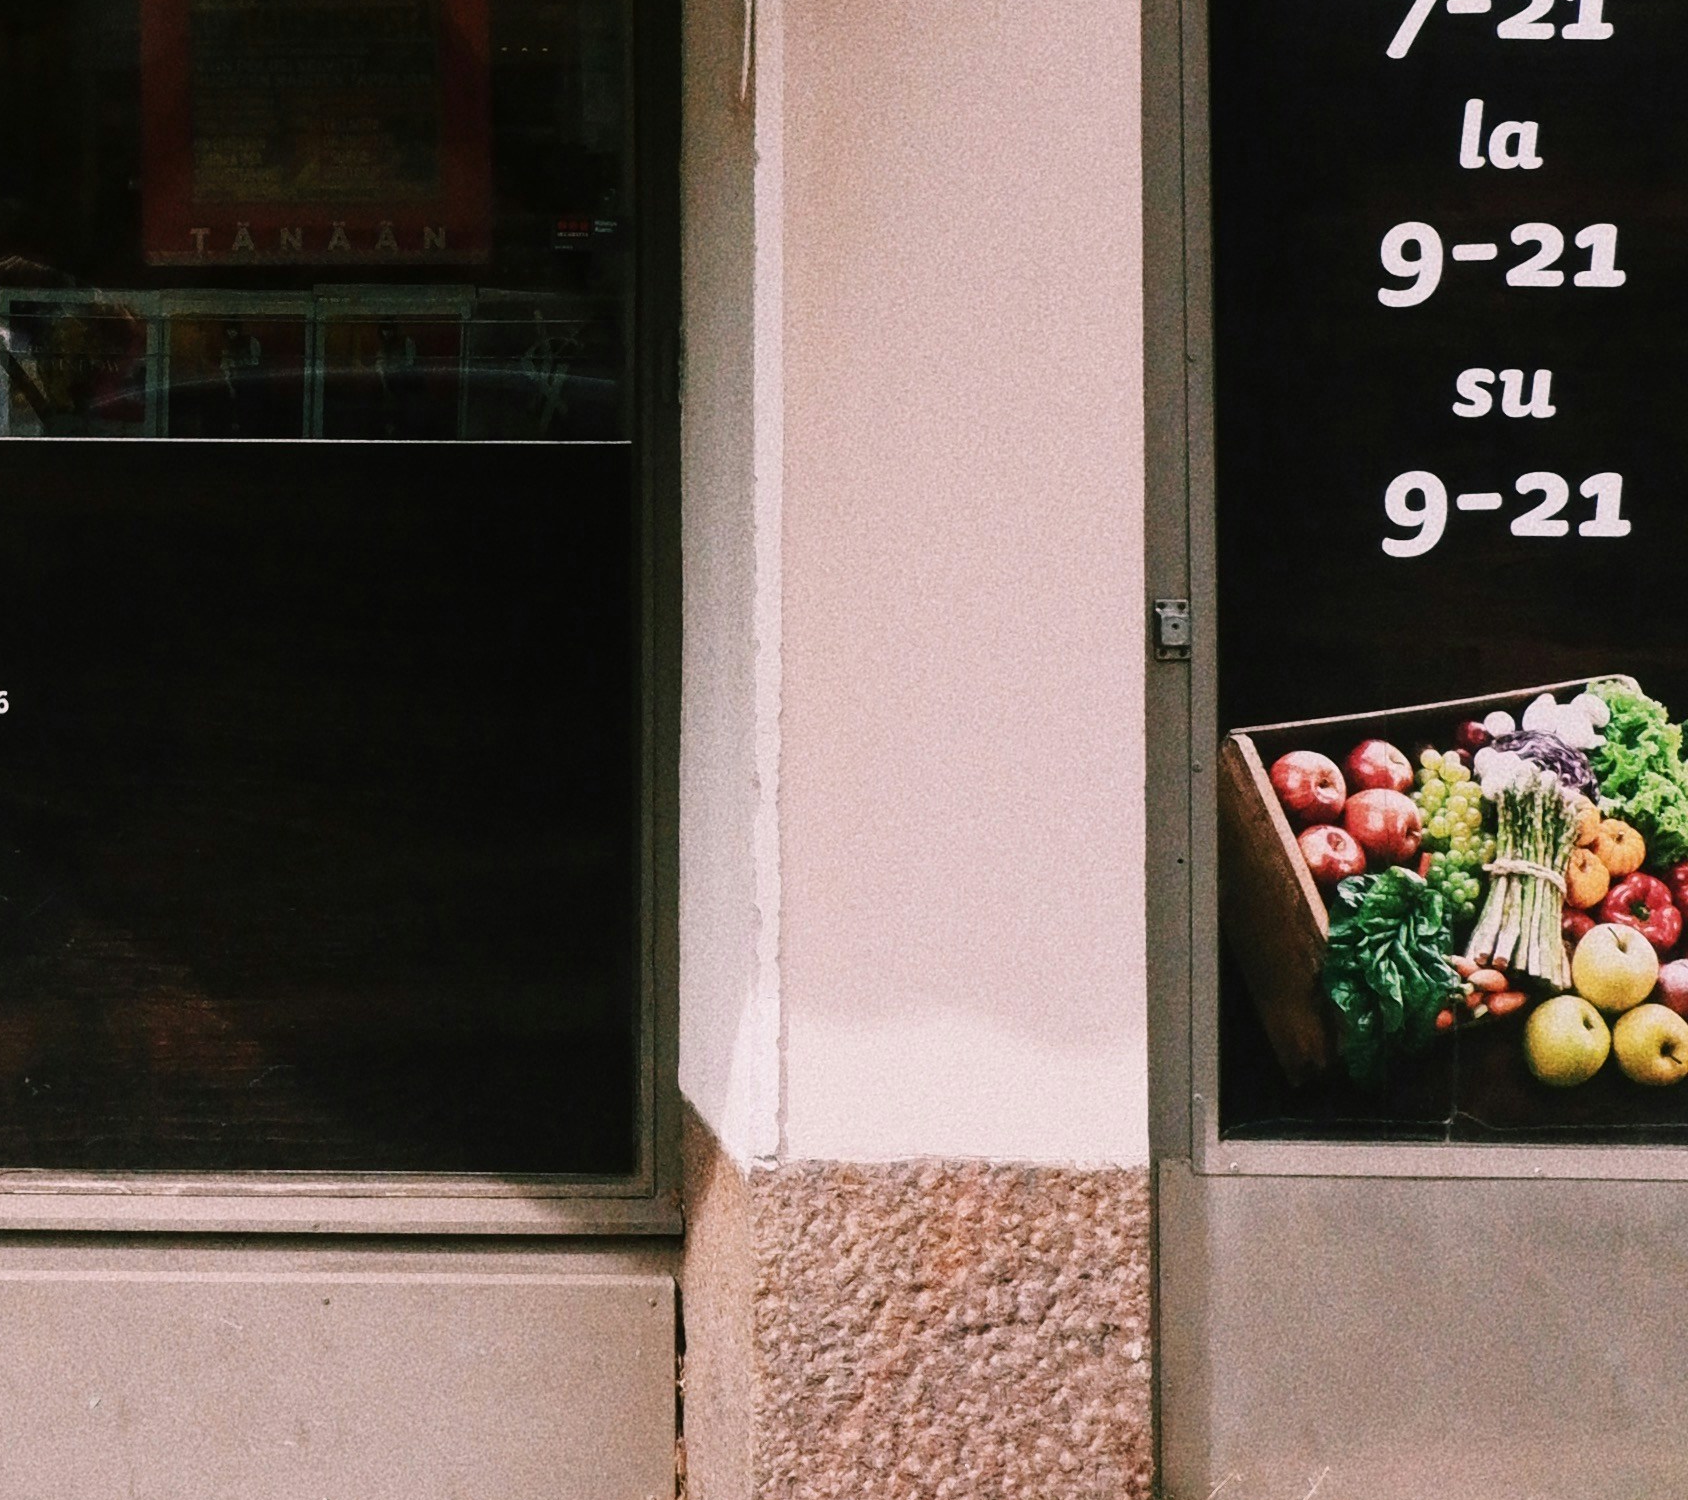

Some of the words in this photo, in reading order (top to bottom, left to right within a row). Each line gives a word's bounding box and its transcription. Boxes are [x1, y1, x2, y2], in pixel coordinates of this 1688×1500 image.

[1458, 97, 1545, 171] la
[188, 219, 449, 250] TÄNÄÄN
[1376, 220, 1628, 309] 9-21
[1451, 366, 1558, 420] su
[1380, 469, 1633, 559] 9-21
